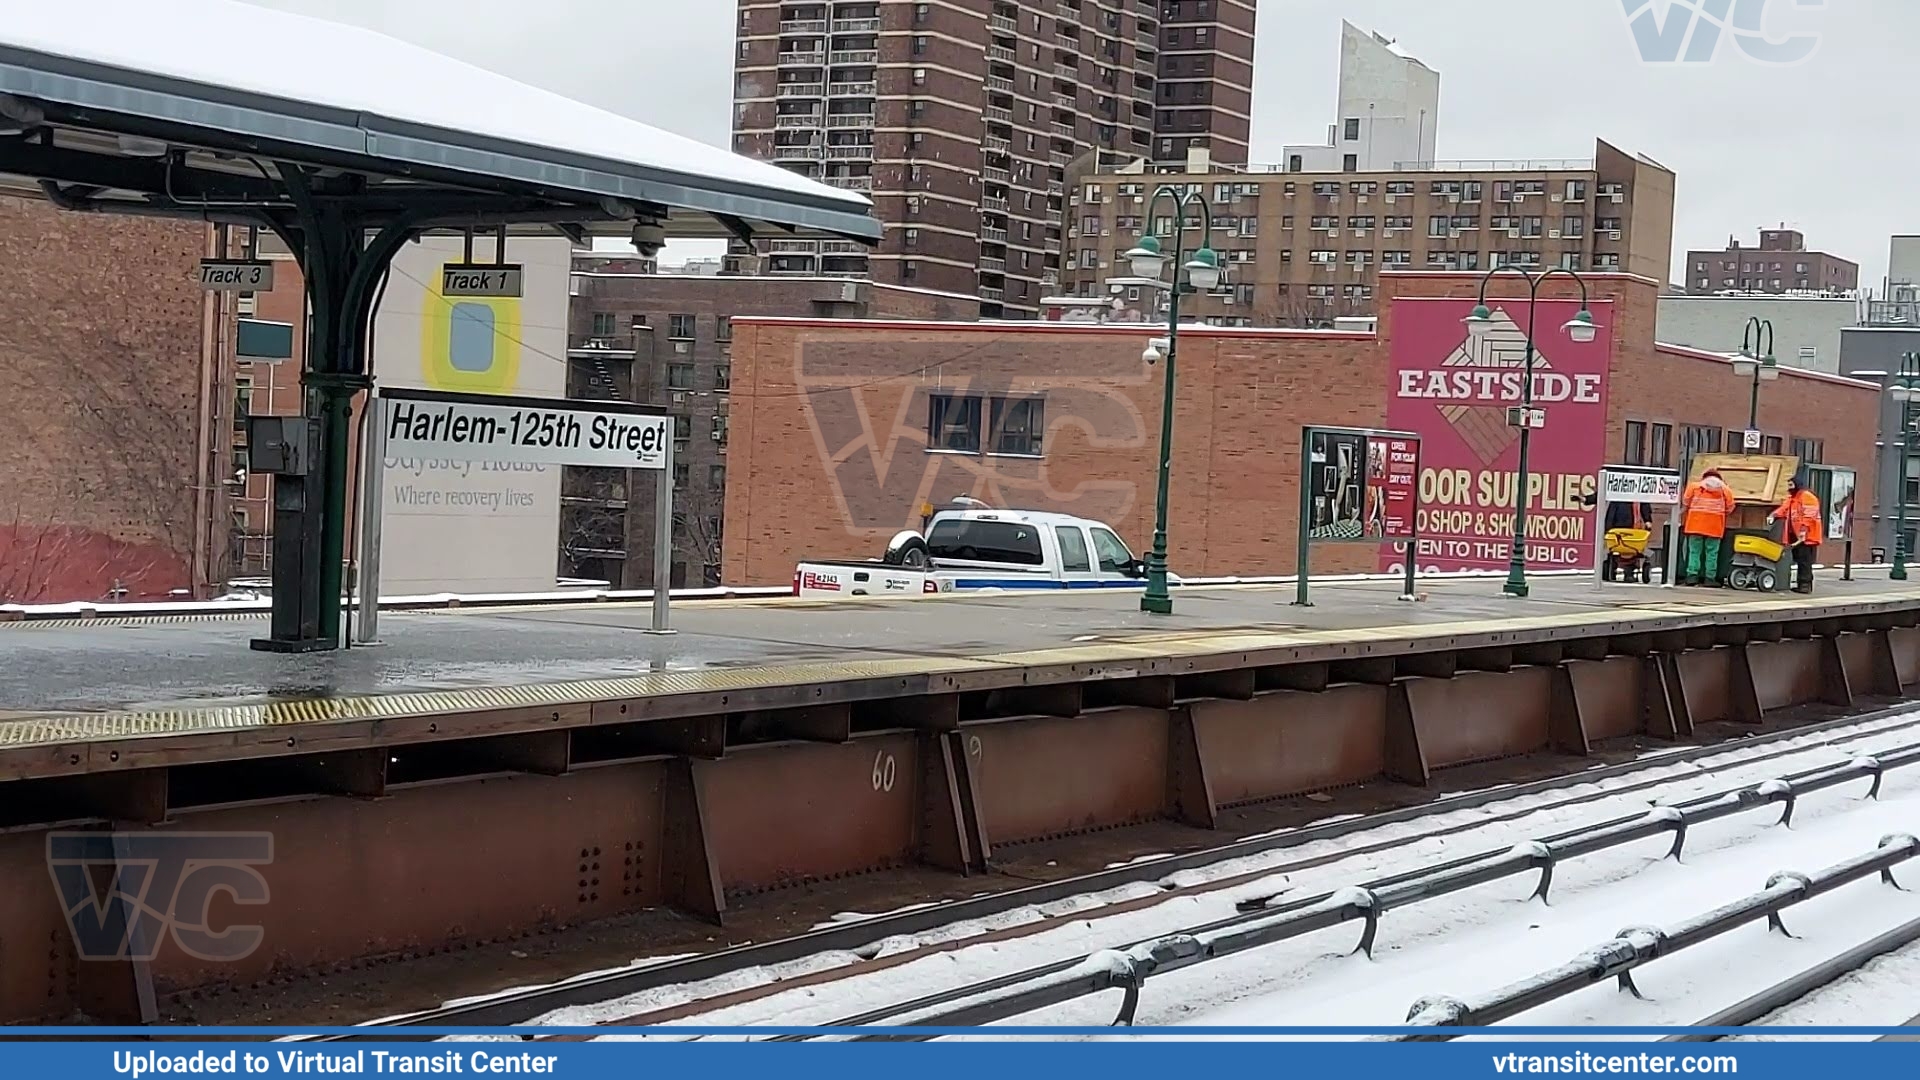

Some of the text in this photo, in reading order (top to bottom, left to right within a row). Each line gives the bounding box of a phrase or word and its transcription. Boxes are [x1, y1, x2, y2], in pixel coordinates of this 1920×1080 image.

[201, 265, 261, 284] Track 3
[444, 270, 507, 289] Track 1
[1397, 370, 1601, 402] EASTSIDE
[389, 403, 665, 452] Harlem-125th Street
[394, 485, 534, 511] Where recovery lives
[1419, 468, 1472, 506] OOR
[1430, 509, 1473, 535] SHOP
[1474, 512, 1486, 536] &
[1488, 513, 1584, 540] SHOWROOM
[1393, 539, 1579, 564] OEN TO THE UBLIC
[872, 750, 895, 792] 60
